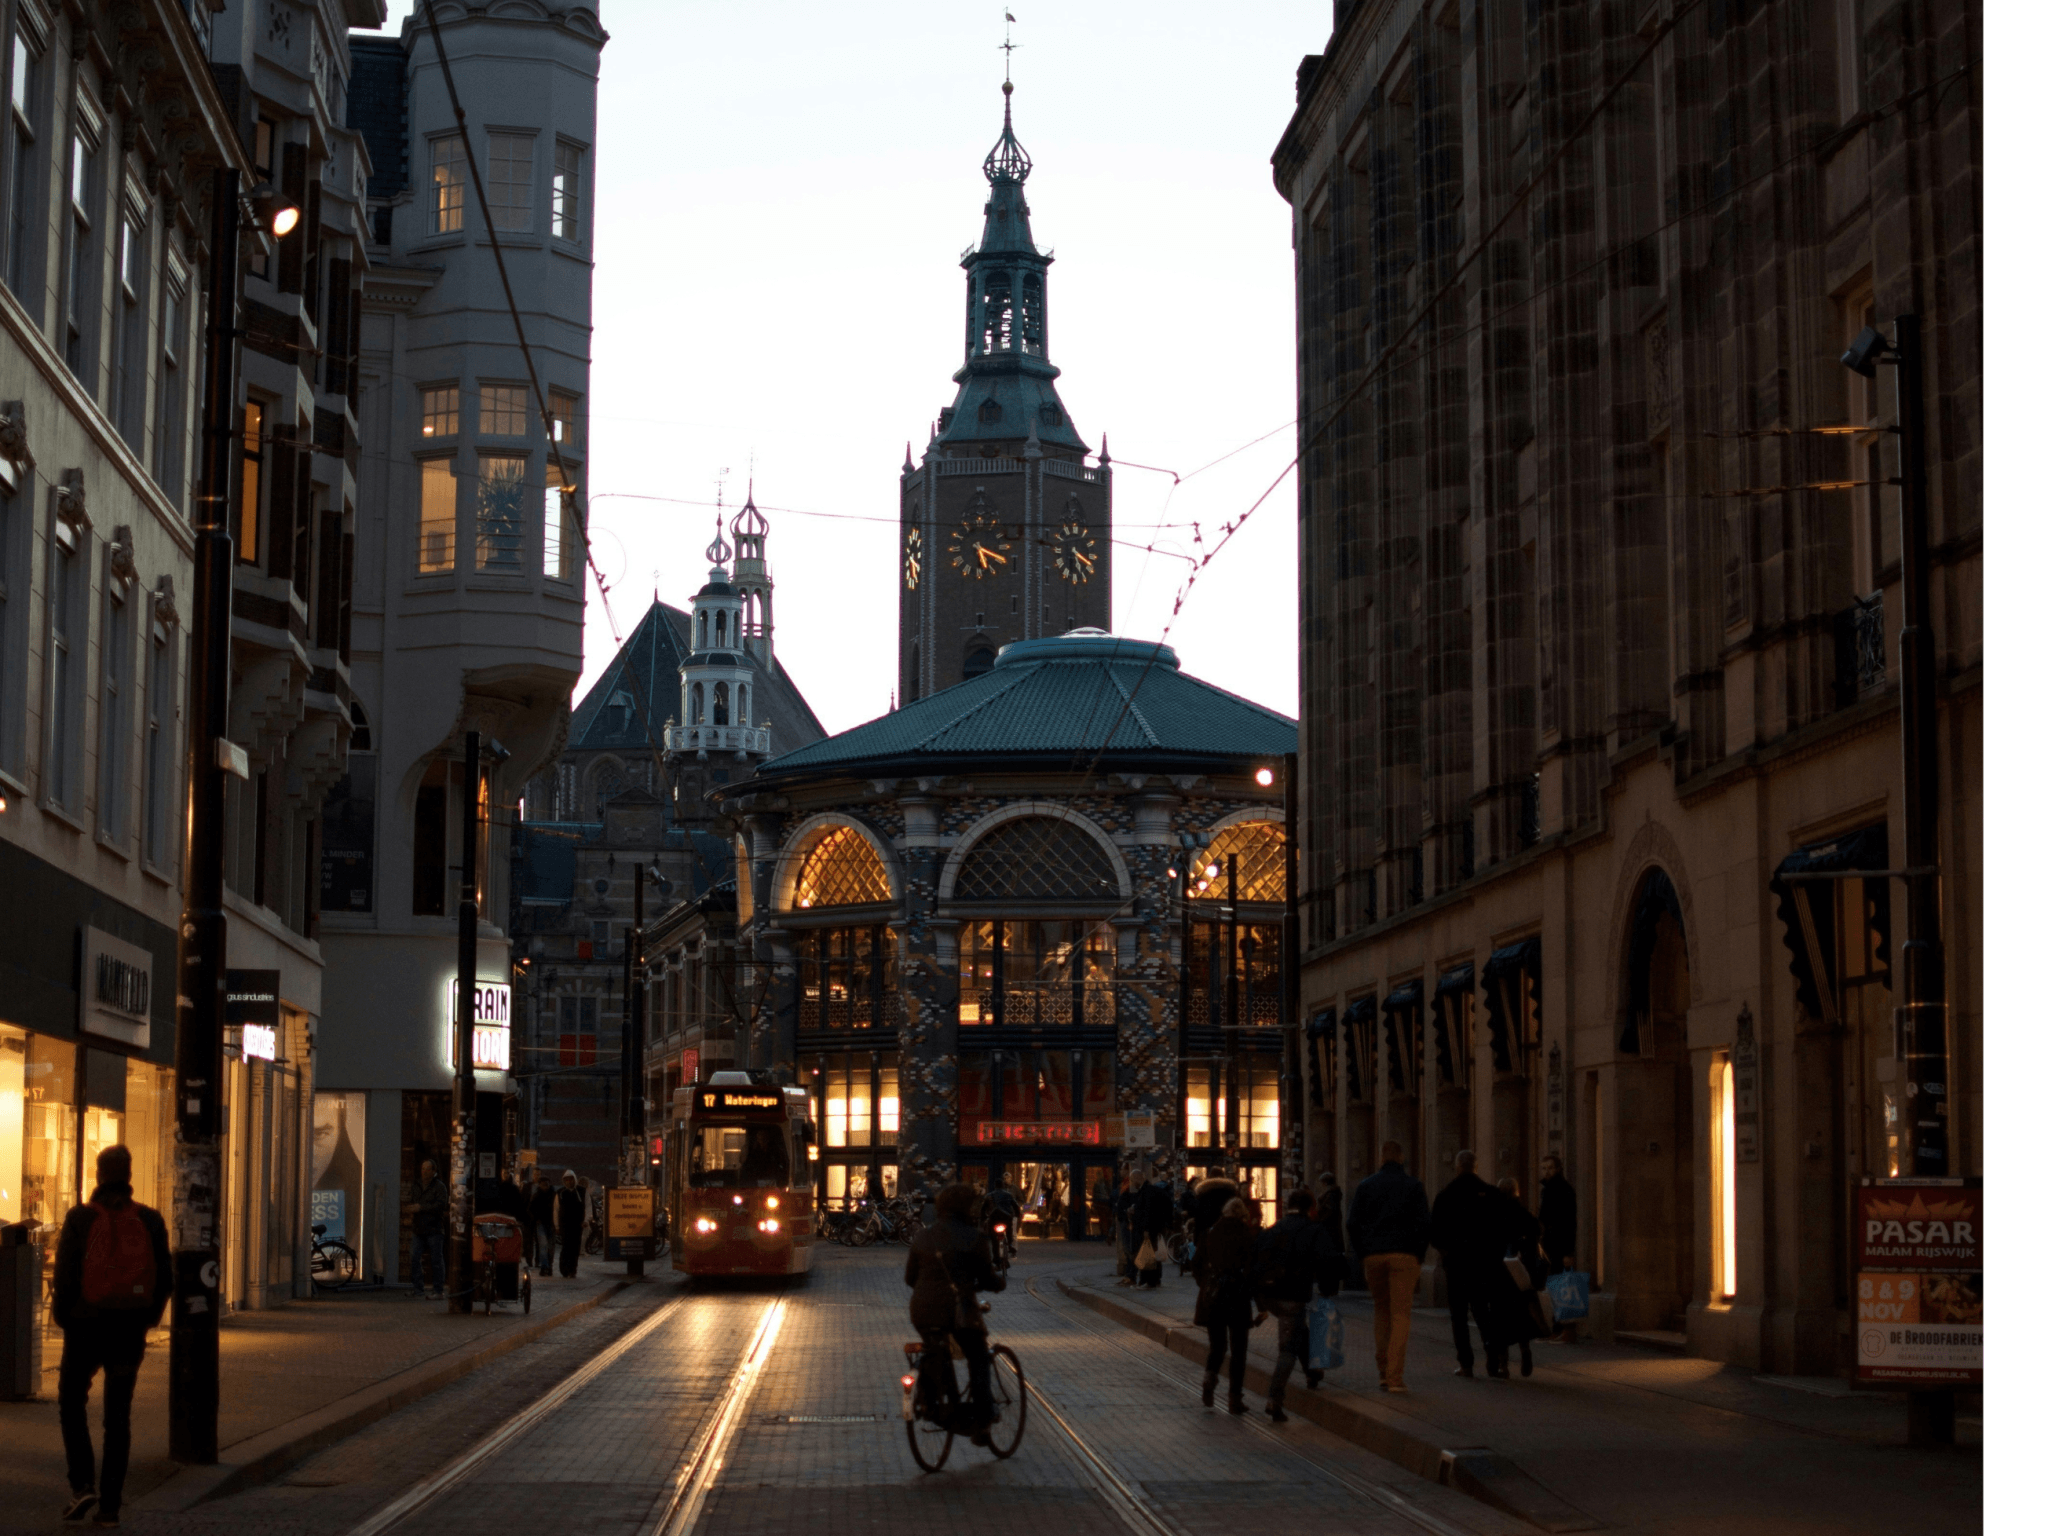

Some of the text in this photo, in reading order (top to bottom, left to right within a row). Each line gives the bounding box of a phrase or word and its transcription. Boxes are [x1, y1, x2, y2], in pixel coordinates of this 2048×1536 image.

[703, 1093, 716, 1108] 17
[1865, 1220, 1976, 1244] PASAR
[1865, 1246, 1976, 1258] MALAM RIJSWIJK
[1859, 1279, 1915, 1300] 8 & 9
[1860, 1302, 1905, 1319] NOV
